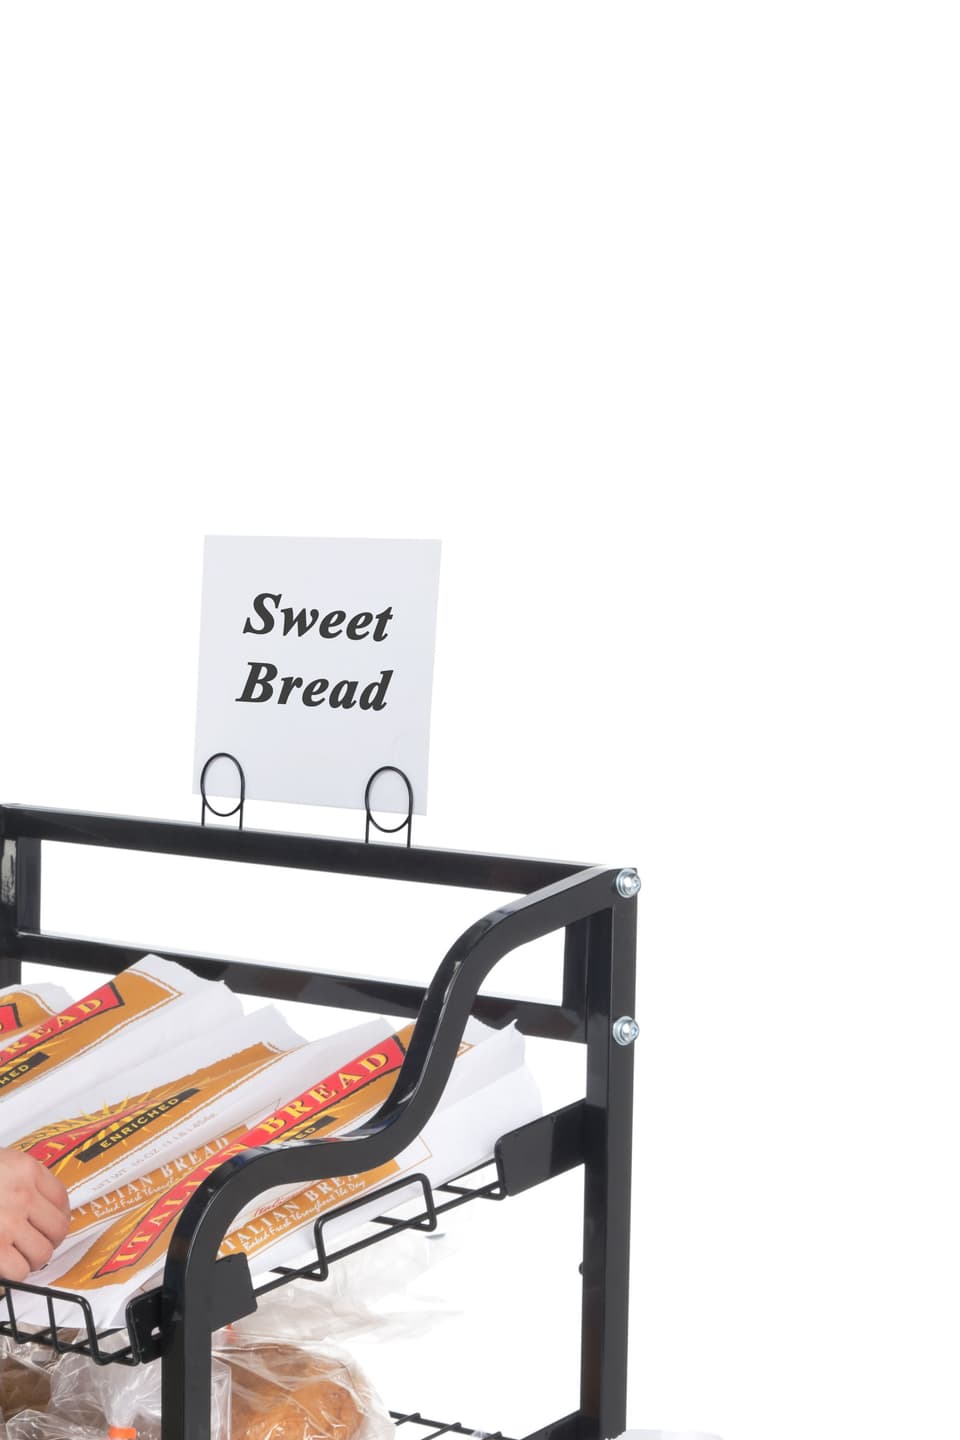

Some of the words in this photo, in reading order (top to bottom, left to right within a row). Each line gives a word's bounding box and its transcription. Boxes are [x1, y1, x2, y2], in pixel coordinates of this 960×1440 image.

[243, 593, 393, 642] Sweet
[235, 662, 394, 711] Bread
[255, 1053, 389, 1134] BREAD
[100, 1098, 180, 1149] ENRICHED
[69, 1175, 154, 1222] TALIAN
[304, 1174, 359, 1203] BRE
